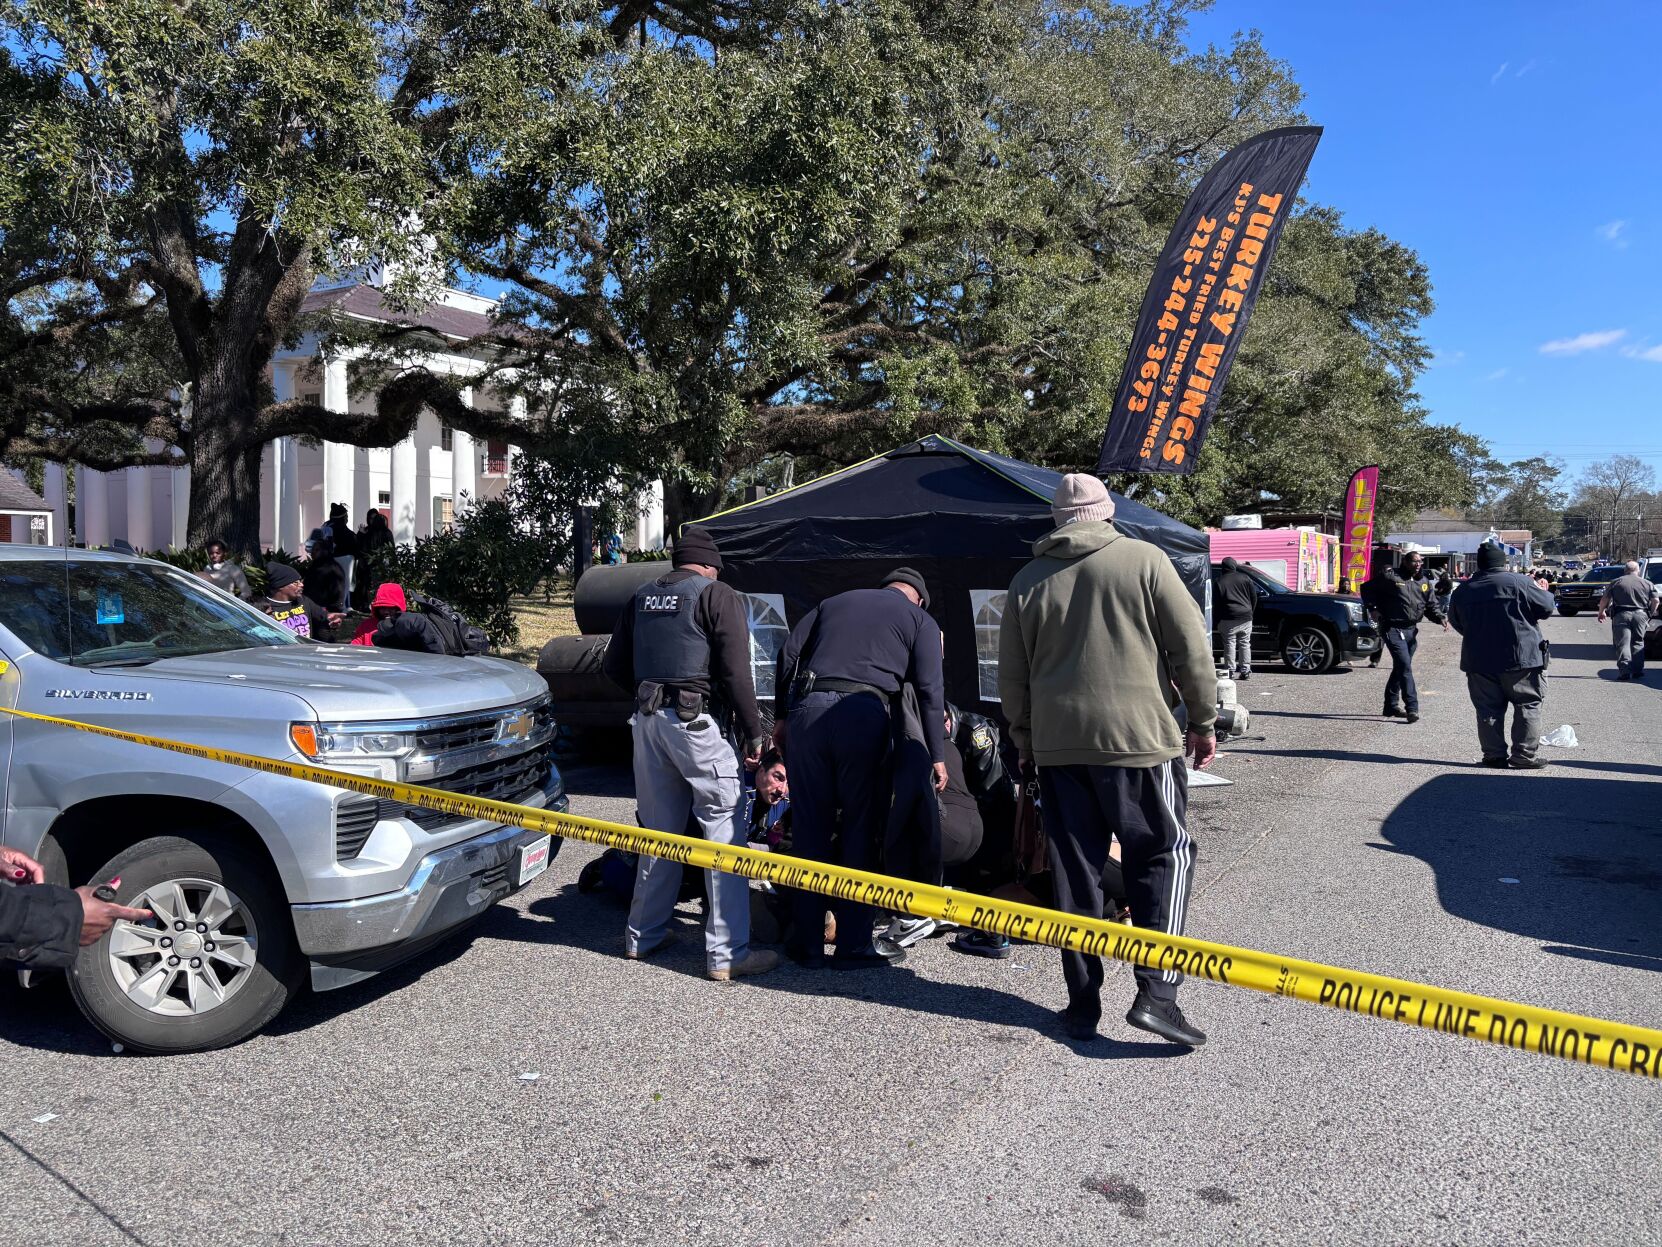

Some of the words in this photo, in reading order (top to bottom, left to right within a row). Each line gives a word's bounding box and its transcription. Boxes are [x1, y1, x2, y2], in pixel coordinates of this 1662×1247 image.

[1209, 226, 1235, 272] BEST
[1210, 193, 1283, 336] TURKEY
[1128, 215, 1217, 413] 225-244-3673
[1189, 273, 1217, 324] FRIED
[1161, 328, 1198, 397] TURKEY
[1139, 401, 1171, 459] WINGS
[1162, 343, 1225, 465] WINGS
[644, 595, 679, 610] POLICE
[44, 689, 153, 701] SILVERADO
[733, 856, 777, 880] POLICE
[778, 865, 808, 888] LINE
[809, 872, 830, 893] DO
[831, 877, 862, 900] NOT
[862, 883, 914, 912] CROSS
[970, 906, 1034, 938] POLICE
[1035, 920, 1078, 948] LINE
[1080, 929, 1109, 956] DO
[1112, 936, 1157, 967] NOT
[1158, 945, 1233, 983] CROSS
[1319, 978, 1411, 1021] POLICE
[1417, 999, 1480, 1037] LINE
[1488, 1013, 1528, 1050] DO
[1538, 1023, 1601, 1064] NOT
